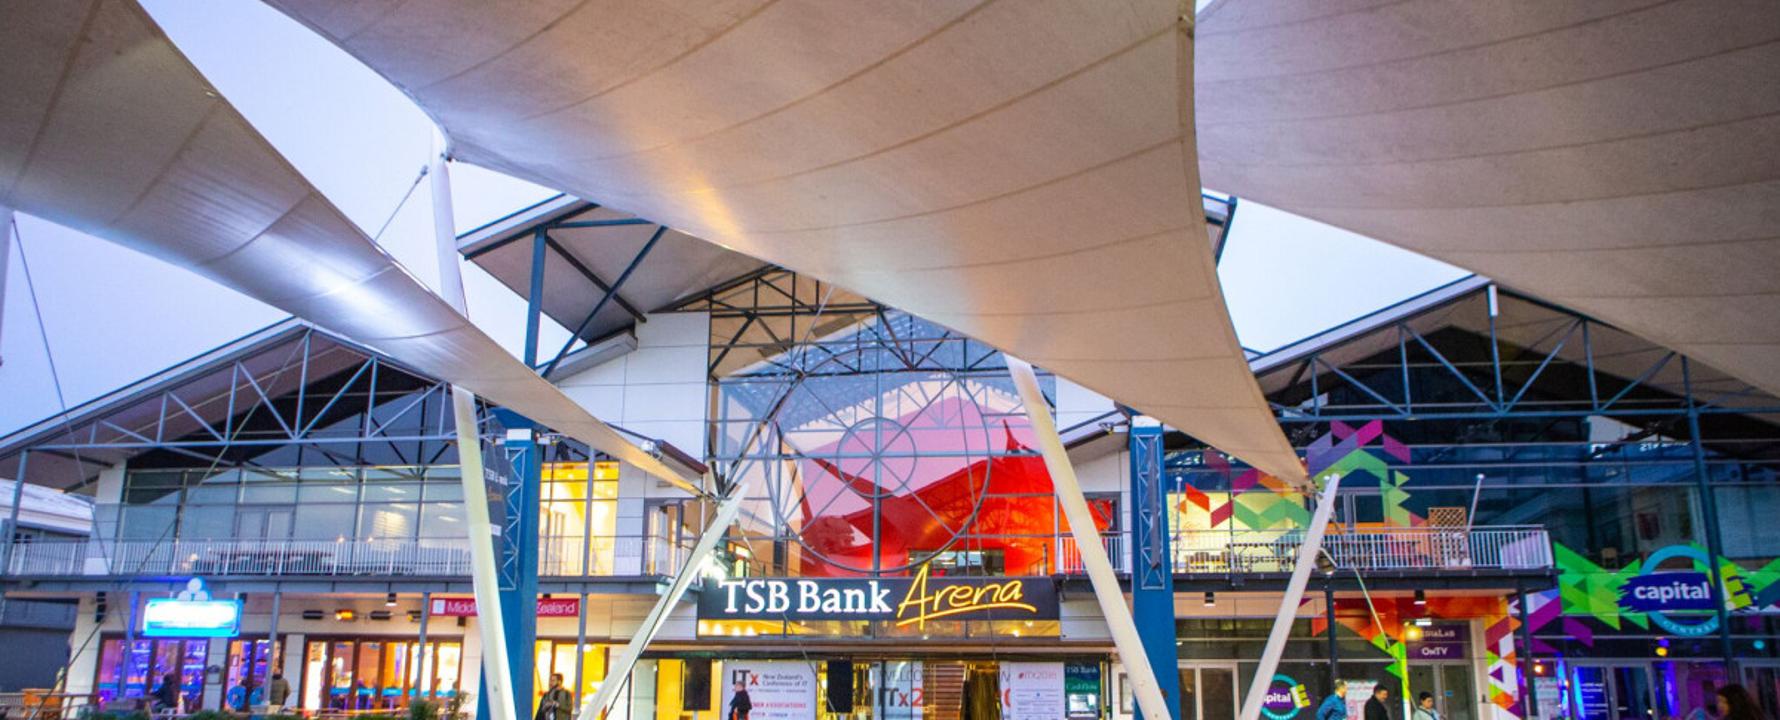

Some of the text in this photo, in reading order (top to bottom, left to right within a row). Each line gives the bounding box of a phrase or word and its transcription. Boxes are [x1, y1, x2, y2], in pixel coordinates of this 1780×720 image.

[719, 563, 1032, 631] TSB Bank Arena
[1634, 581, 1711, 603] capital
[1264, 692, 1292, 705] pital
